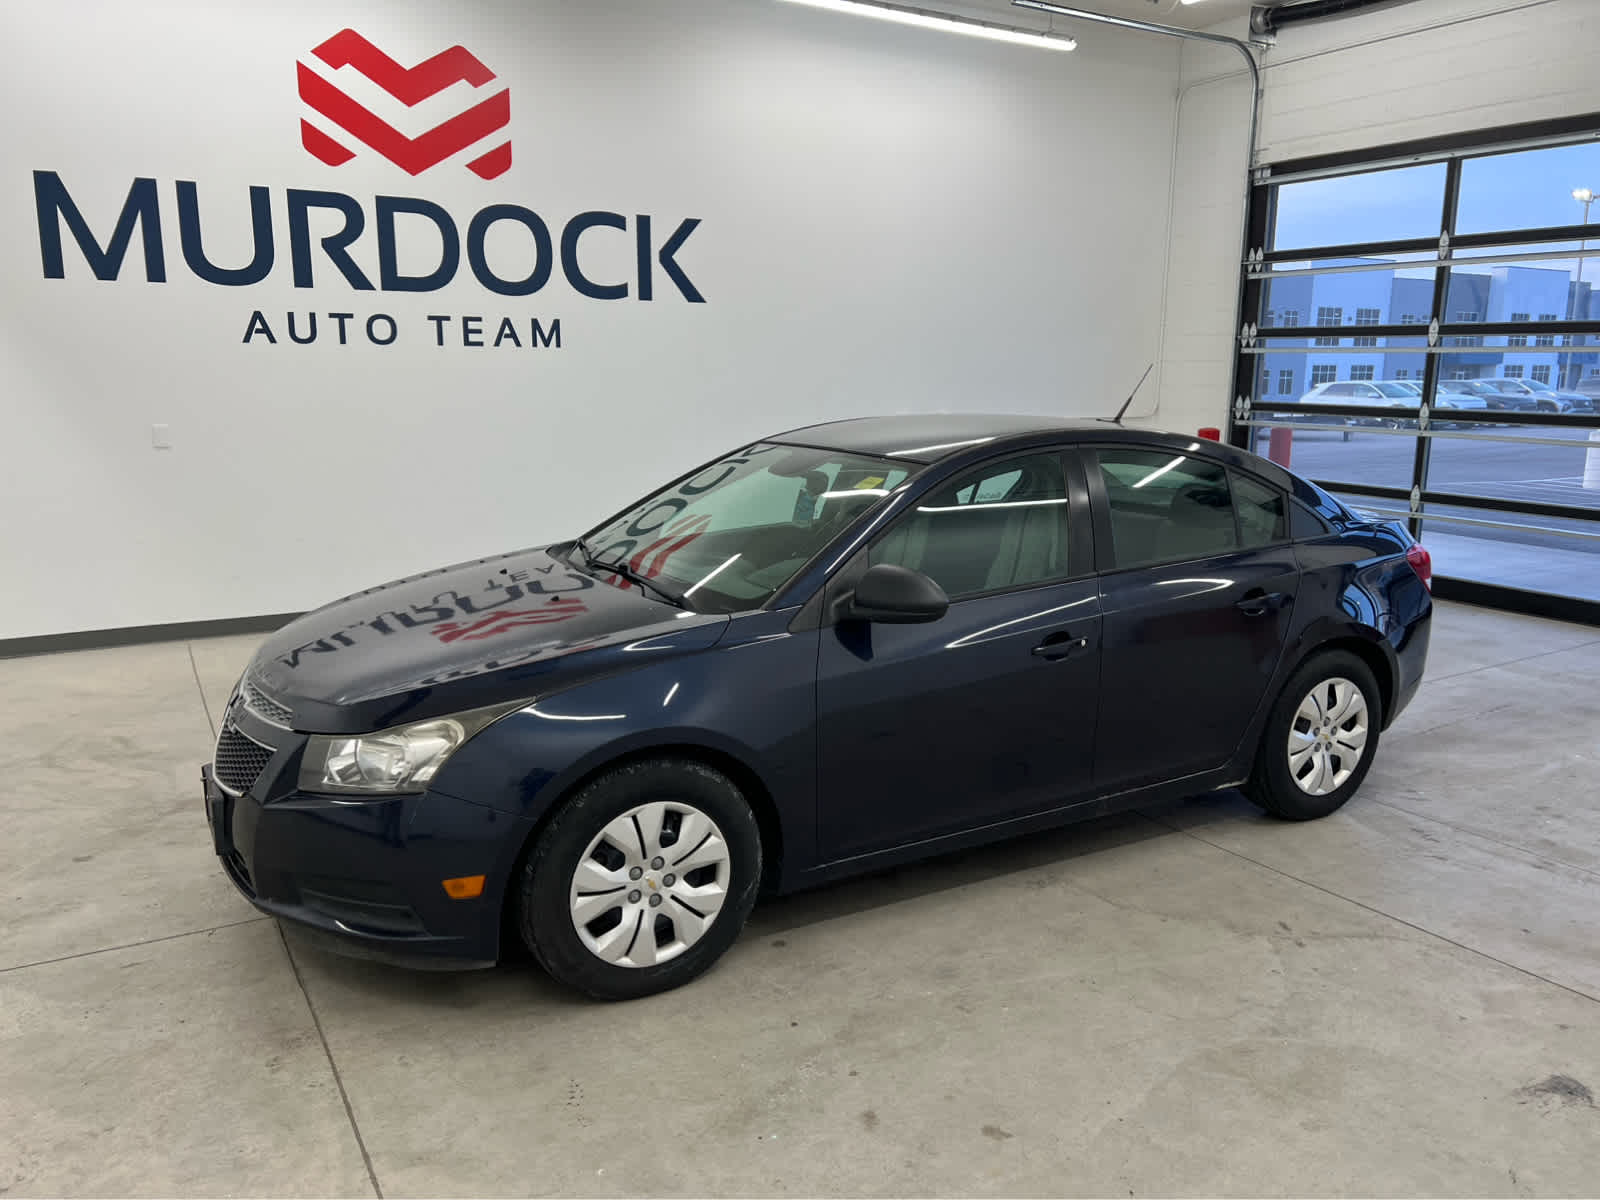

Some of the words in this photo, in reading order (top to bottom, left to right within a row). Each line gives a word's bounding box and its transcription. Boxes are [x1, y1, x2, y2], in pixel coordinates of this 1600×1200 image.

[33, 170, 706, 304] MURDOCK
[242, 310, 398, 346] AUTO
[427, 316, 563, 348] TEAM
